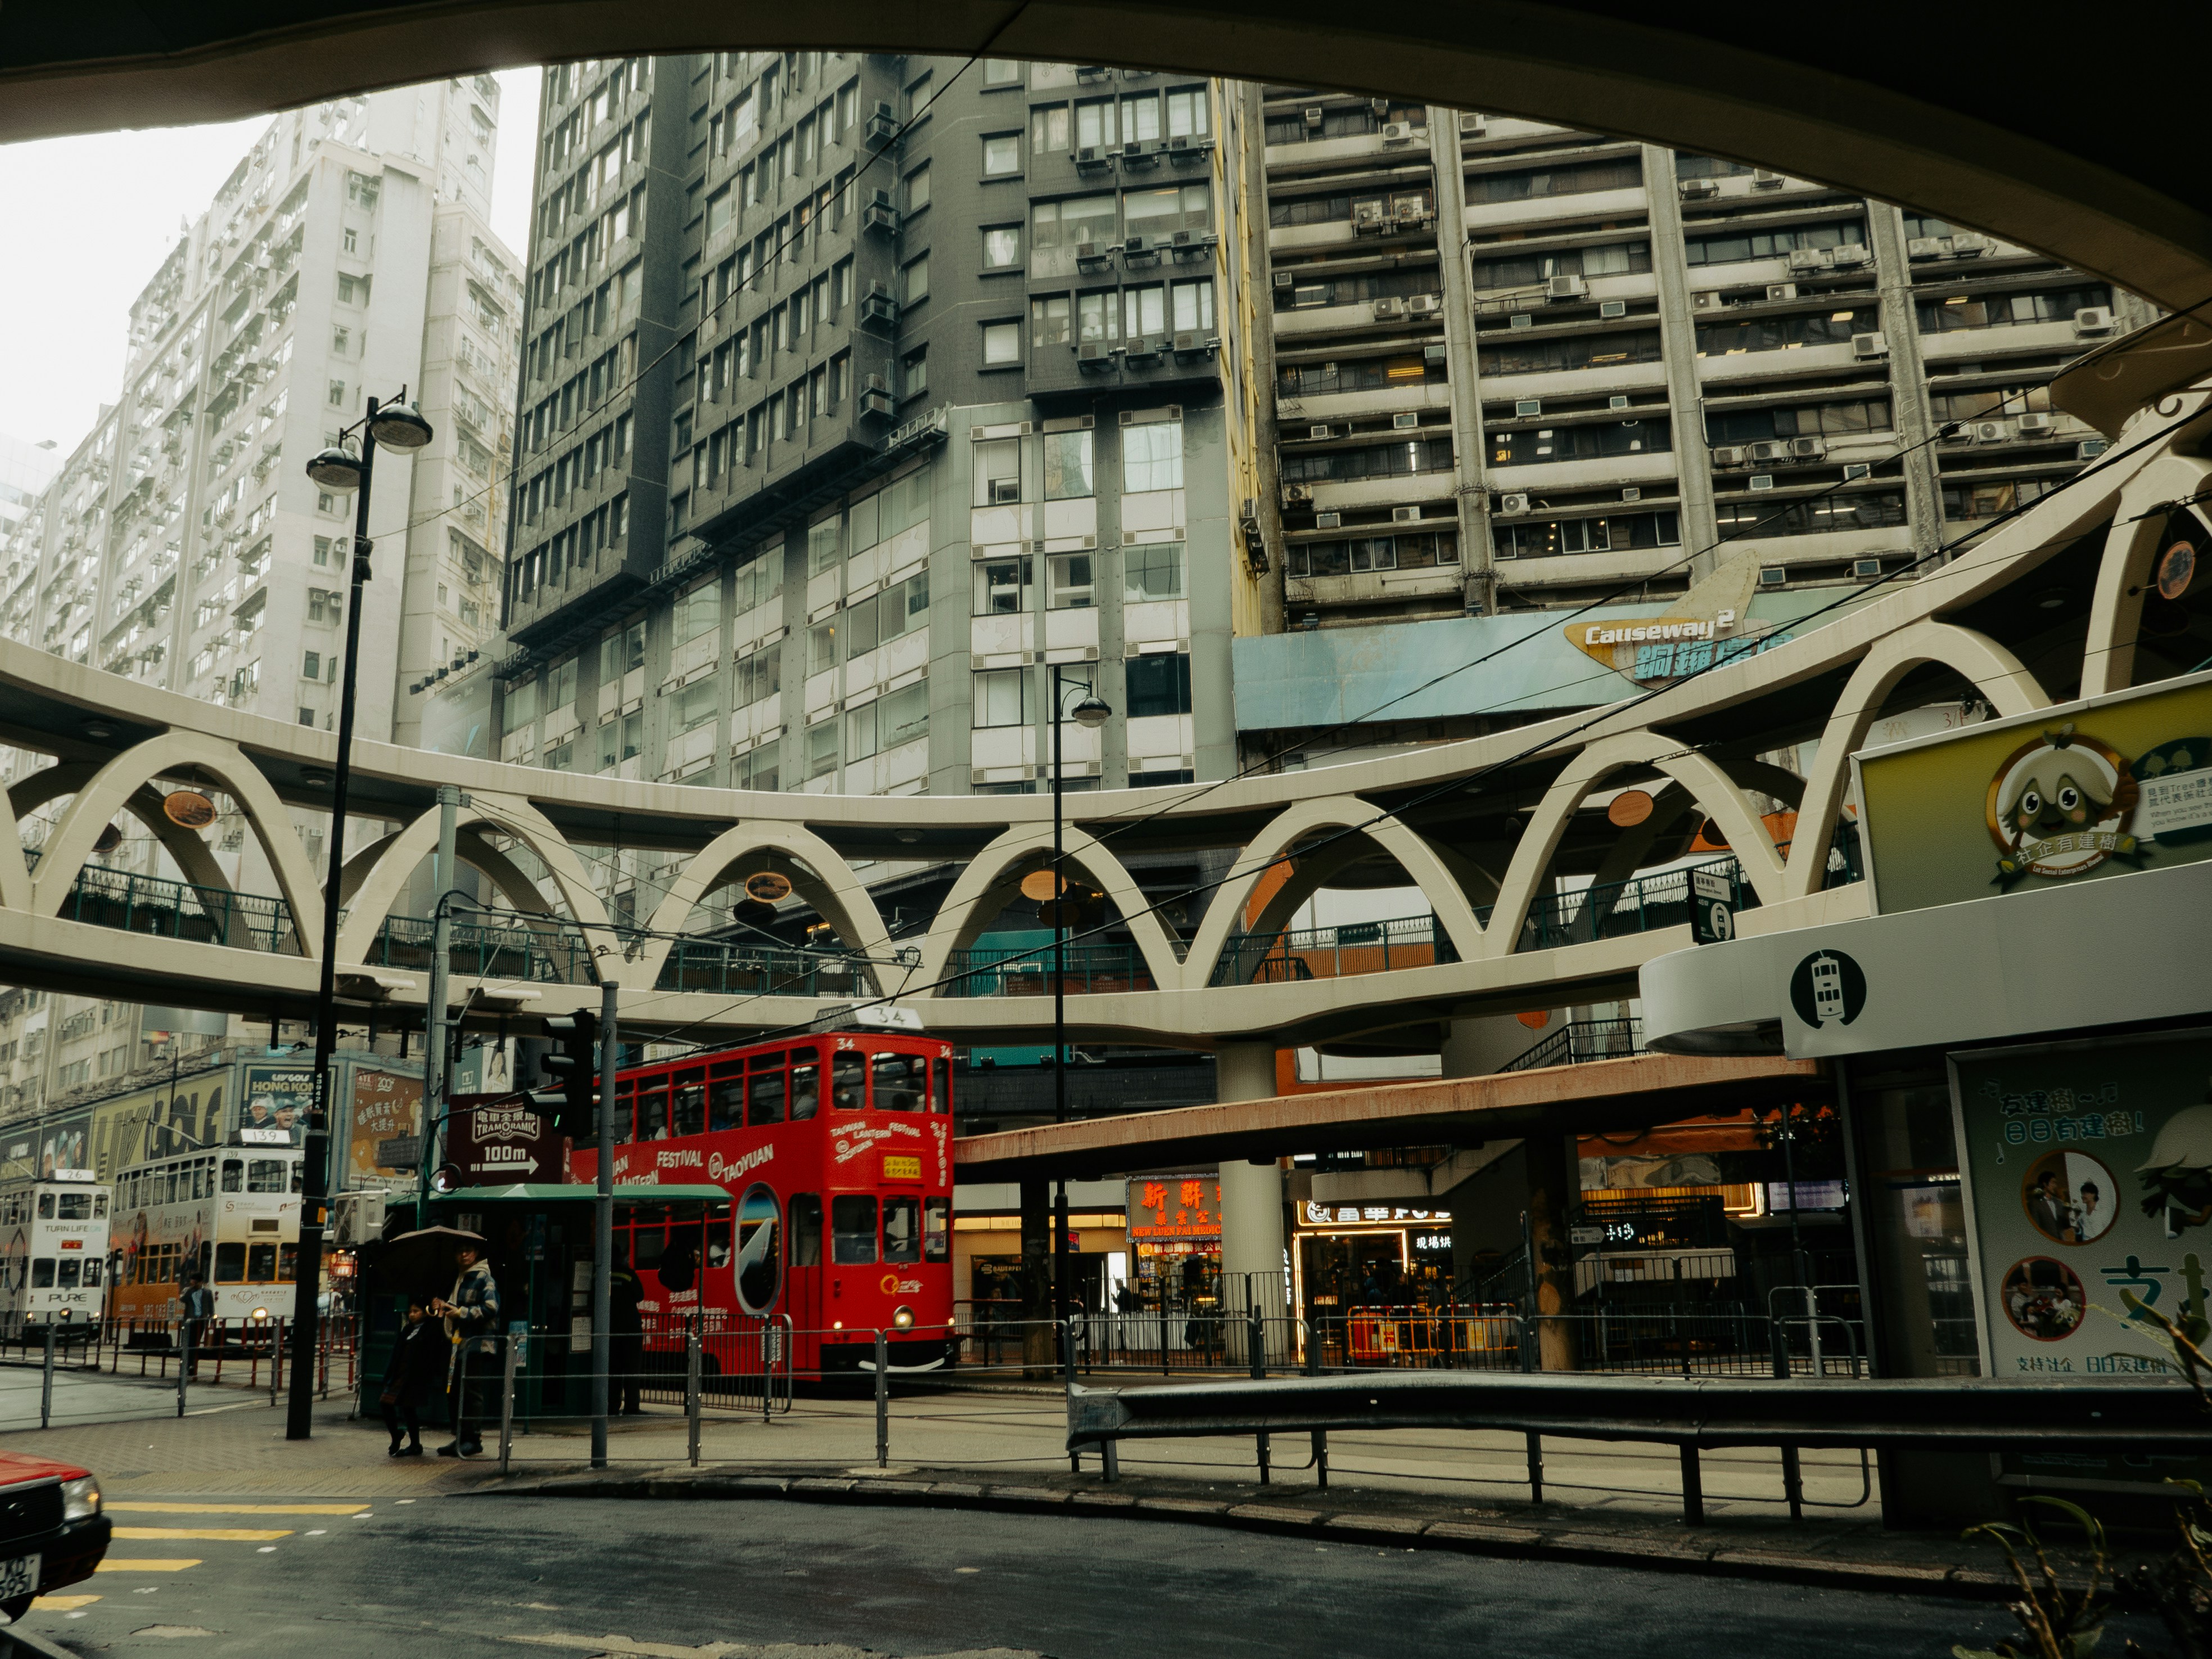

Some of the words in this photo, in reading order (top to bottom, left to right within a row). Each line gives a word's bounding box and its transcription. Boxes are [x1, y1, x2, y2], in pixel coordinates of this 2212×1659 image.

[2016, 834, 2117, 865] 社企有建樹
[873, 1007, 906, 1025] 34
[837, 1038, 855, 1050] 34
[940, 1044, 952, 1058] 34
[252, 1081, 290, 1092] HONG
[253, 1130, 277, 1142] 139
[476, 1121, 536, 1137] TRAMORAMIC
[484, 1145, 526, 1161] 100m
[657, 1150, 703, 1169] FESTIVAL
[722, 1143, 774, 1183] TAOYUAN
[67, 1170, 82, 1179] 26
[1132, 1227, 1152, 1237] NEW
[1153, 1226, 1175, 1237] LUEN
[1176, 1225, 1191, 1236] FAI
[48, 1293, 87, 1302] PURE
[2016, 1356, 2075, 1373] 支持社企
